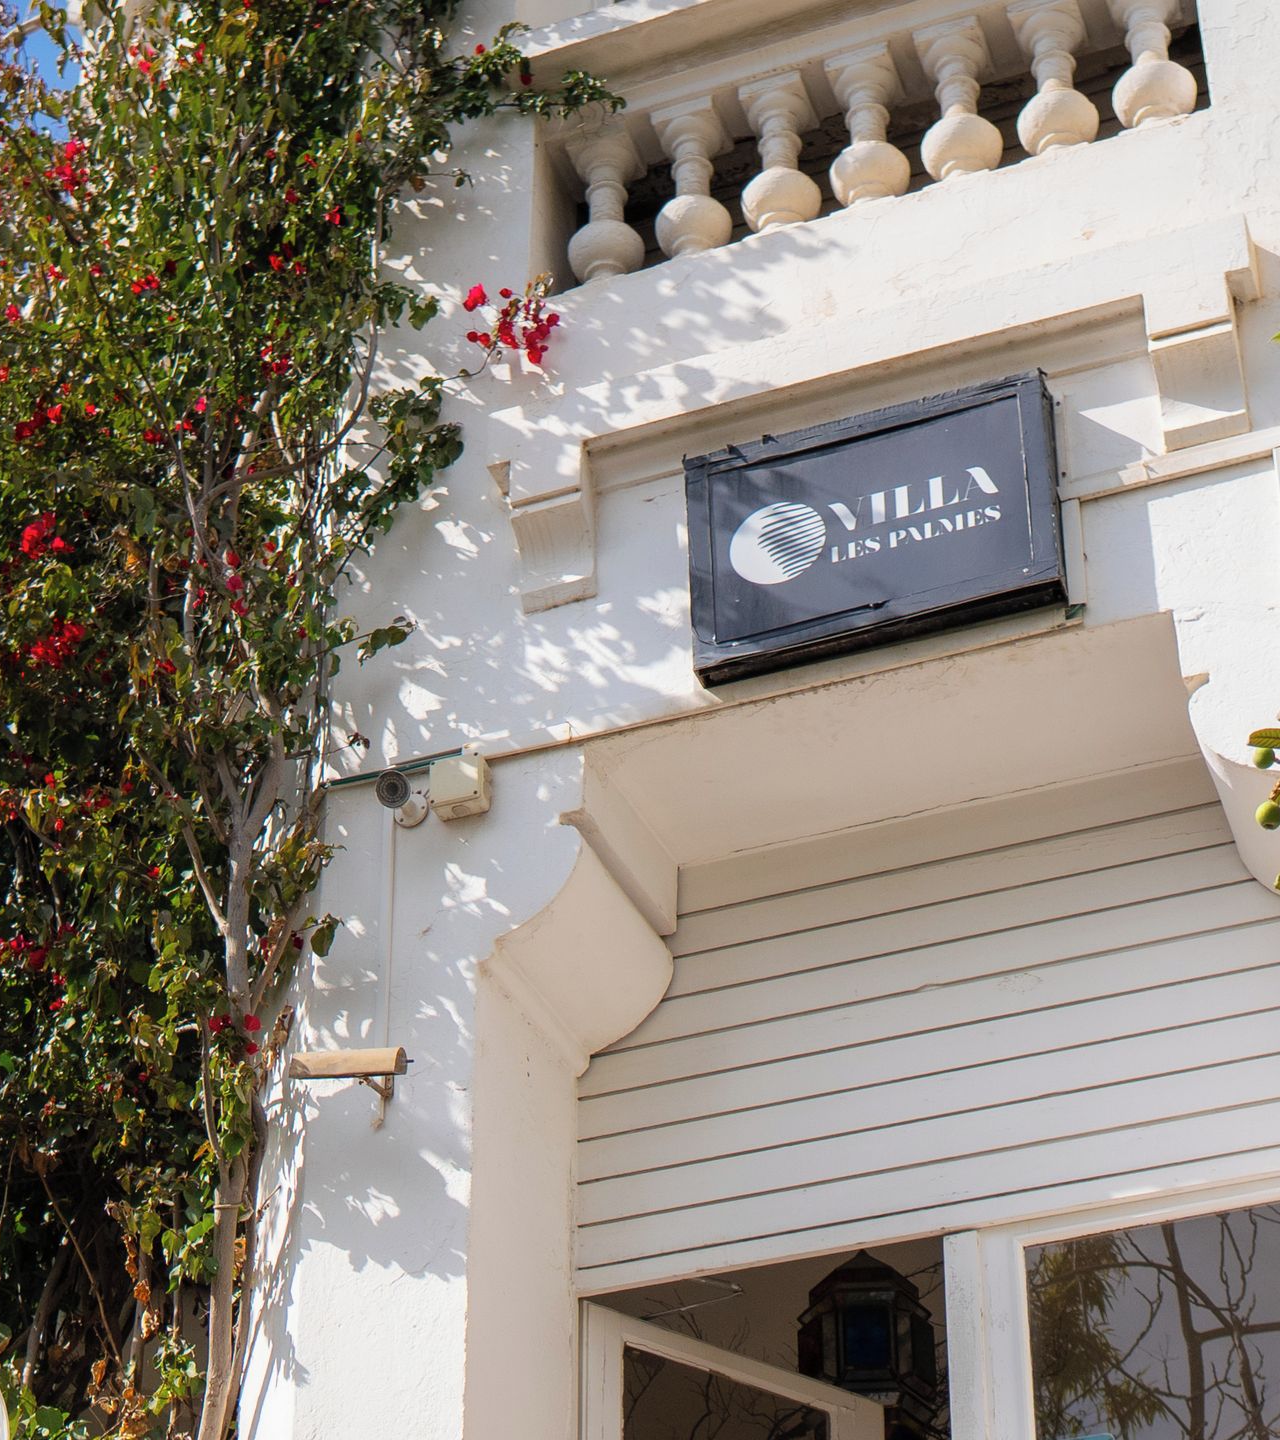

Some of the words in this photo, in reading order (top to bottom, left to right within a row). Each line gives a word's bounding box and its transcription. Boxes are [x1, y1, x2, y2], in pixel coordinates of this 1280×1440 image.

[828, 466, 1000, 531] VILLA
[831, 536, 881, 563] LES
[889, 505, 1001, 549] PALMES
